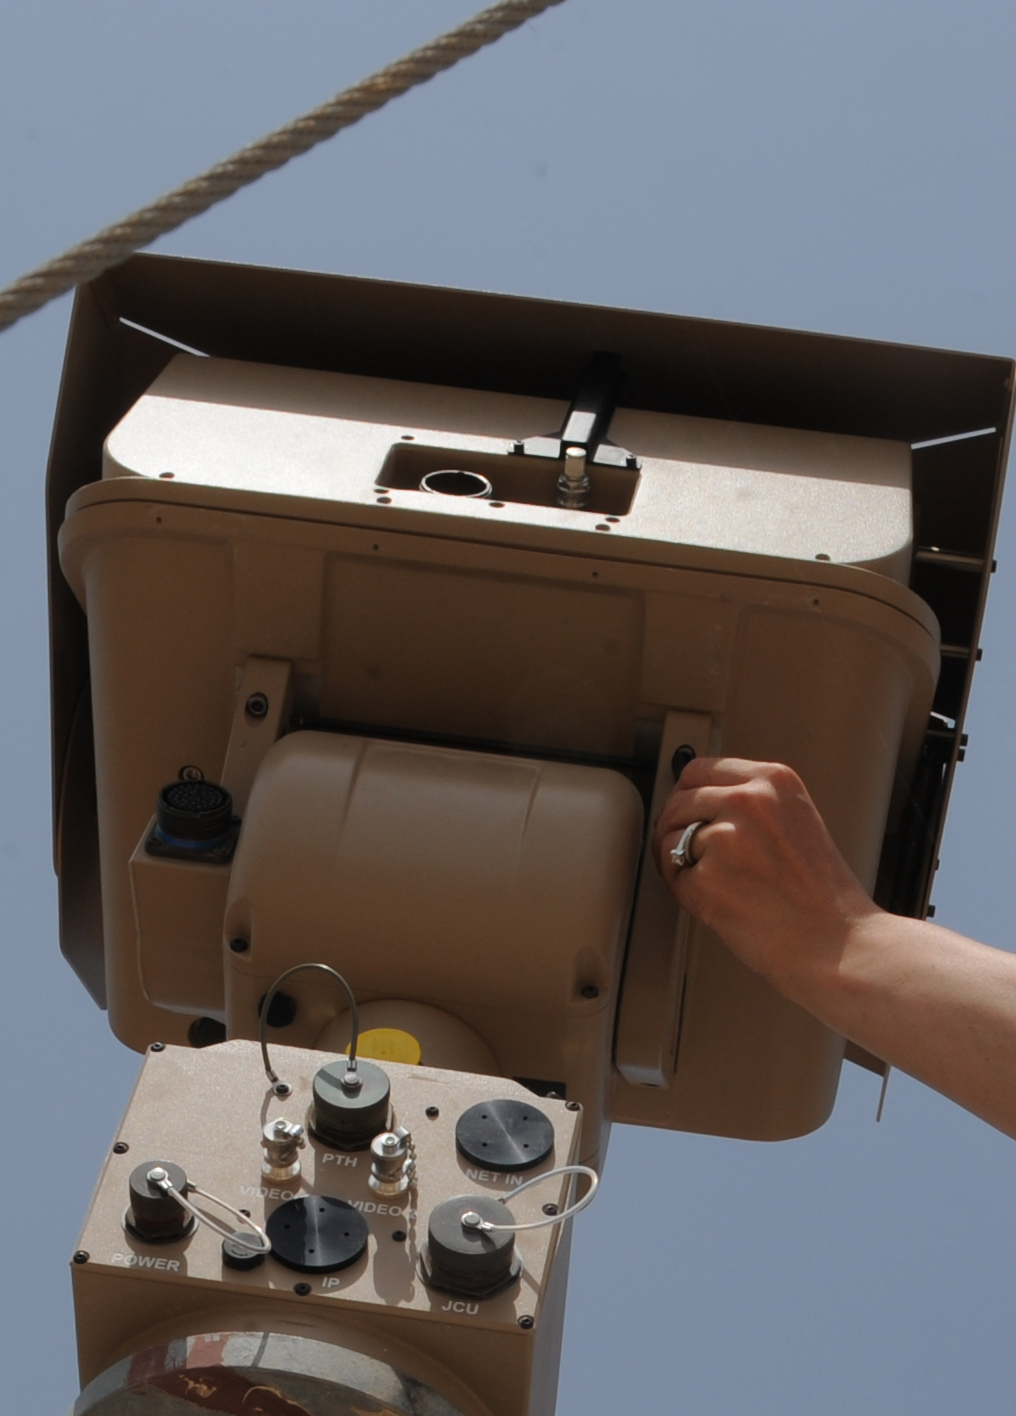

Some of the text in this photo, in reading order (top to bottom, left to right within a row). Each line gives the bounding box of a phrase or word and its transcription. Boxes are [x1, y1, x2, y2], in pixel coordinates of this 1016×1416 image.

[322, 1153, 358, 1168] PTH
[466, 1168, 524, 1186] NET IN
[239, 1185, 295, 1202] VIDEO
[347, 1199, 402, 1217] VIDEO
[111, 1252, 181, 1272] POWER
[321, 1276, 341, 1289] IP
[441, 1299, 479, 1315] JCU
